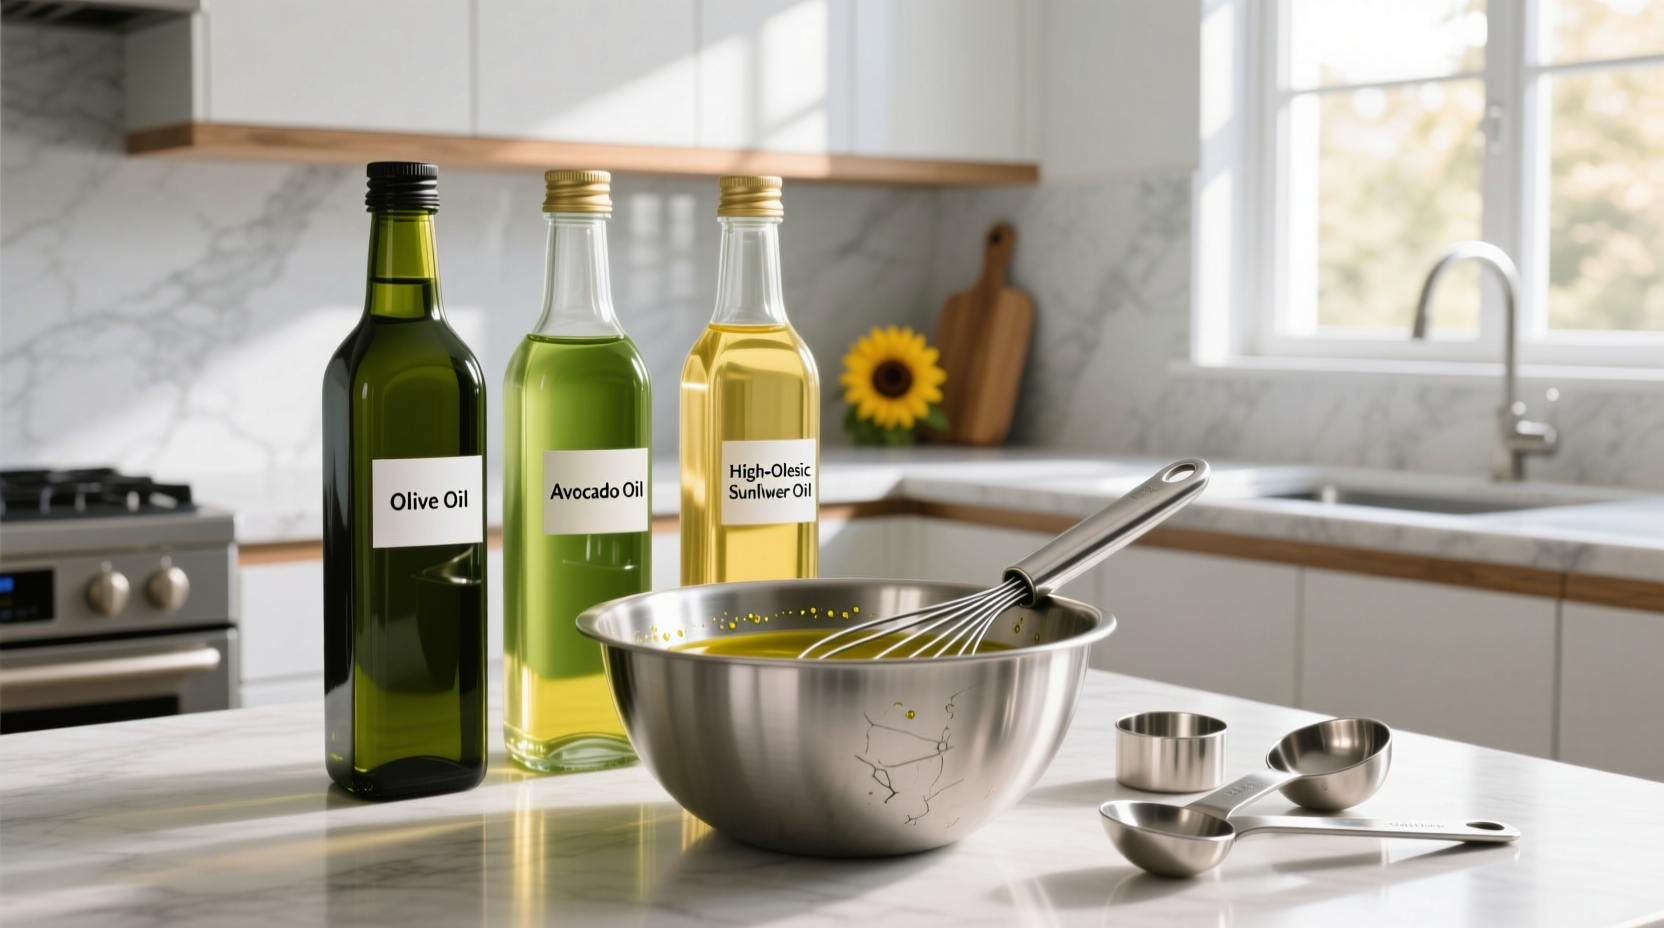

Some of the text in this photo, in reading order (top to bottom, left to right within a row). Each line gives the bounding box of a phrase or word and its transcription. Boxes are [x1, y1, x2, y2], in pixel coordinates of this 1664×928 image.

[729, 462, 812, 483] High-Olesic
[549, 480, 643, 500] Avocado Oil
[792, 482, 812, 498] Oil
[390, 489, 468, 512] Olive Oil
